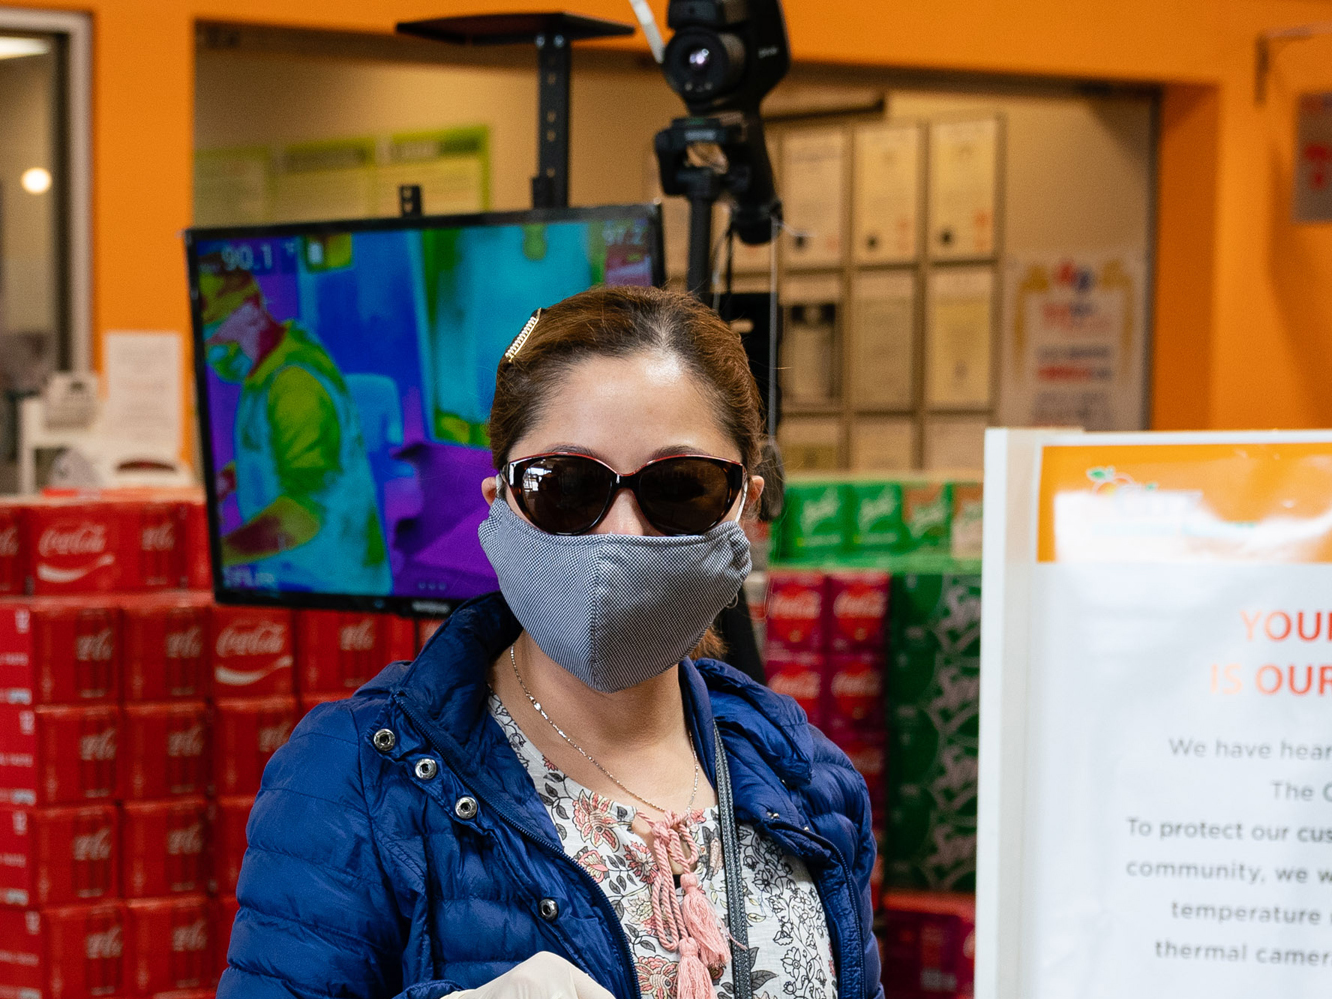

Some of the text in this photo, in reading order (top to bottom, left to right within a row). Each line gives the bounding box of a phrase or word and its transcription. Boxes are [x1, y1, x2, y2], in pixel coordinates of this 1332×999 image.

[221, 243, 272, 270] 90.1
[1211, 663, 1243, 695] IS
[1169, 738, 1208, 758] We
[1215, 738, 1272, 760] have
[1272, 780, 1314, 801] The
[1127, 817, 1152, 837] To
[1159, 820, 1244, 841] protect
[1251, 825, 1289, 841] our
[1126, 860, 1267, 886] community,
[1275, 867, 1309, 884] we
[1172, 900, 1322, 926] temperature
[1155, 940, 1332, 968] thermal camer
